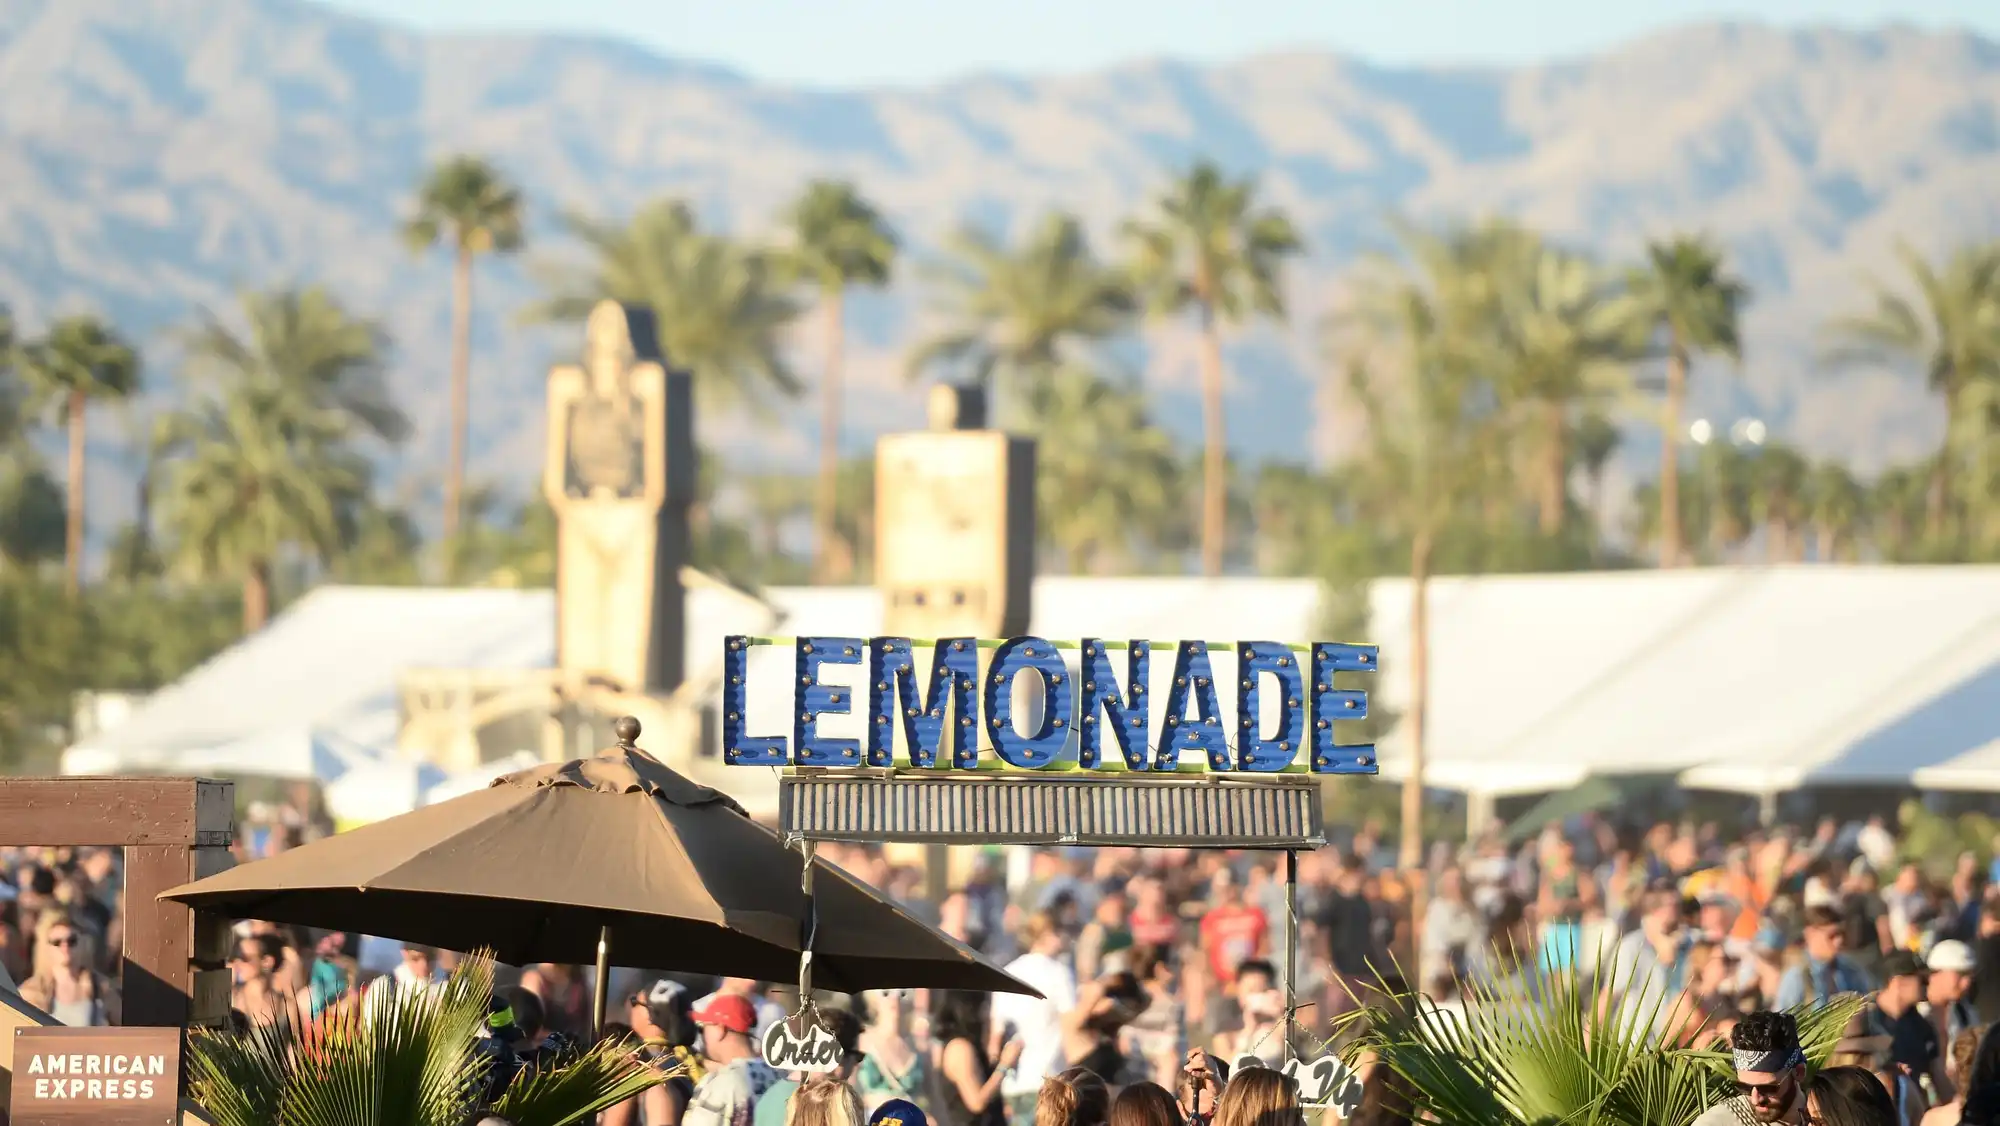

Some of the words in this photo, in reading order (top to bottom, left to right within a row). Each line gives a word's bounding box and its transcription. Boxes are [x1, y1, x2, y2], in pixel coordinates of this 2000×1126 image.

[723, 635, 1379, 774] LEMONADE
[765, 1023, 844, 1066] Order
[27, 1054, 164, 1075] AMERICAN
[35, 1078, 154, 1099] EXPRESS
